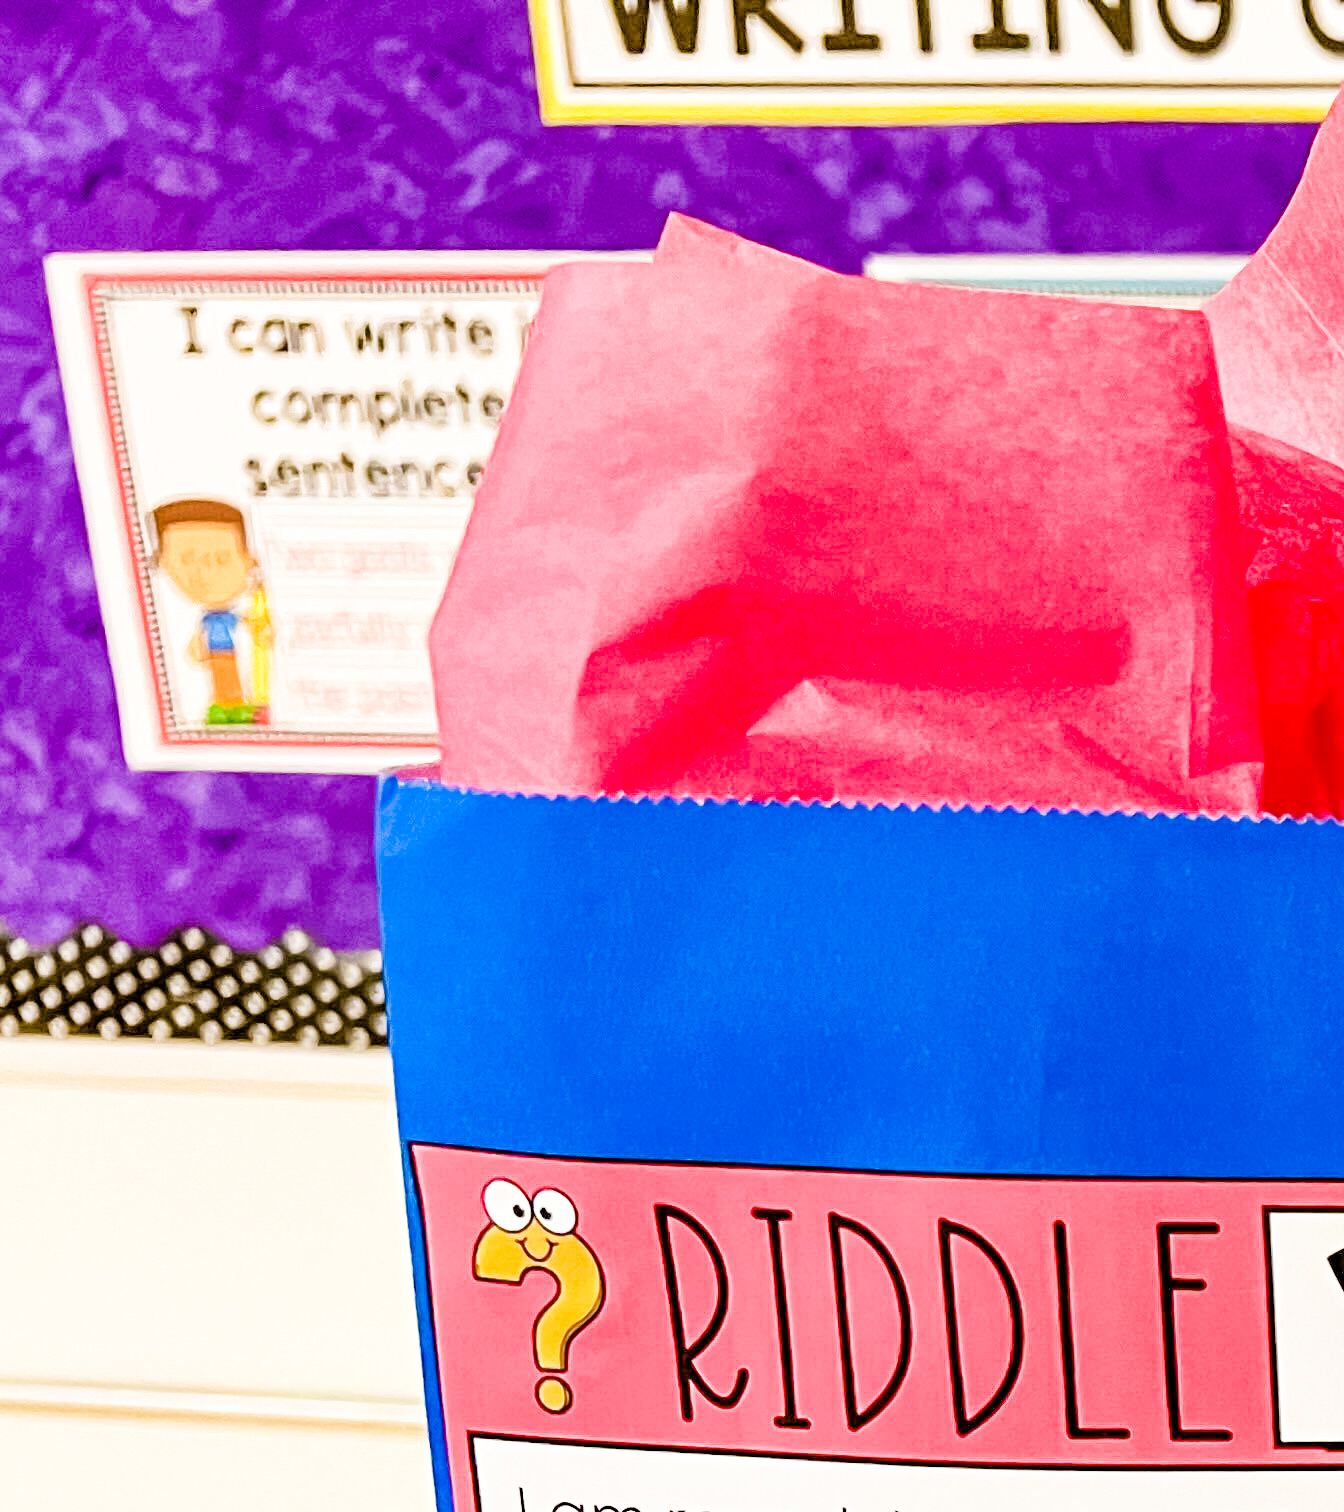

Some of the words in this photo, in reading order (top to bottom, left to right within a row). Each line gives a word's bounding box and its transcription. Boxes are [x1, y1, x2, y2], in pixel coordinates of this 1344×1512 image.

[179, 306, 203, 354] I
[228, 318, 325, 355] can
[347, 314, 494, 354] write
[251, 382, 504, 435] complete
[653, 1203, 1234, 1443] RIDDLE
